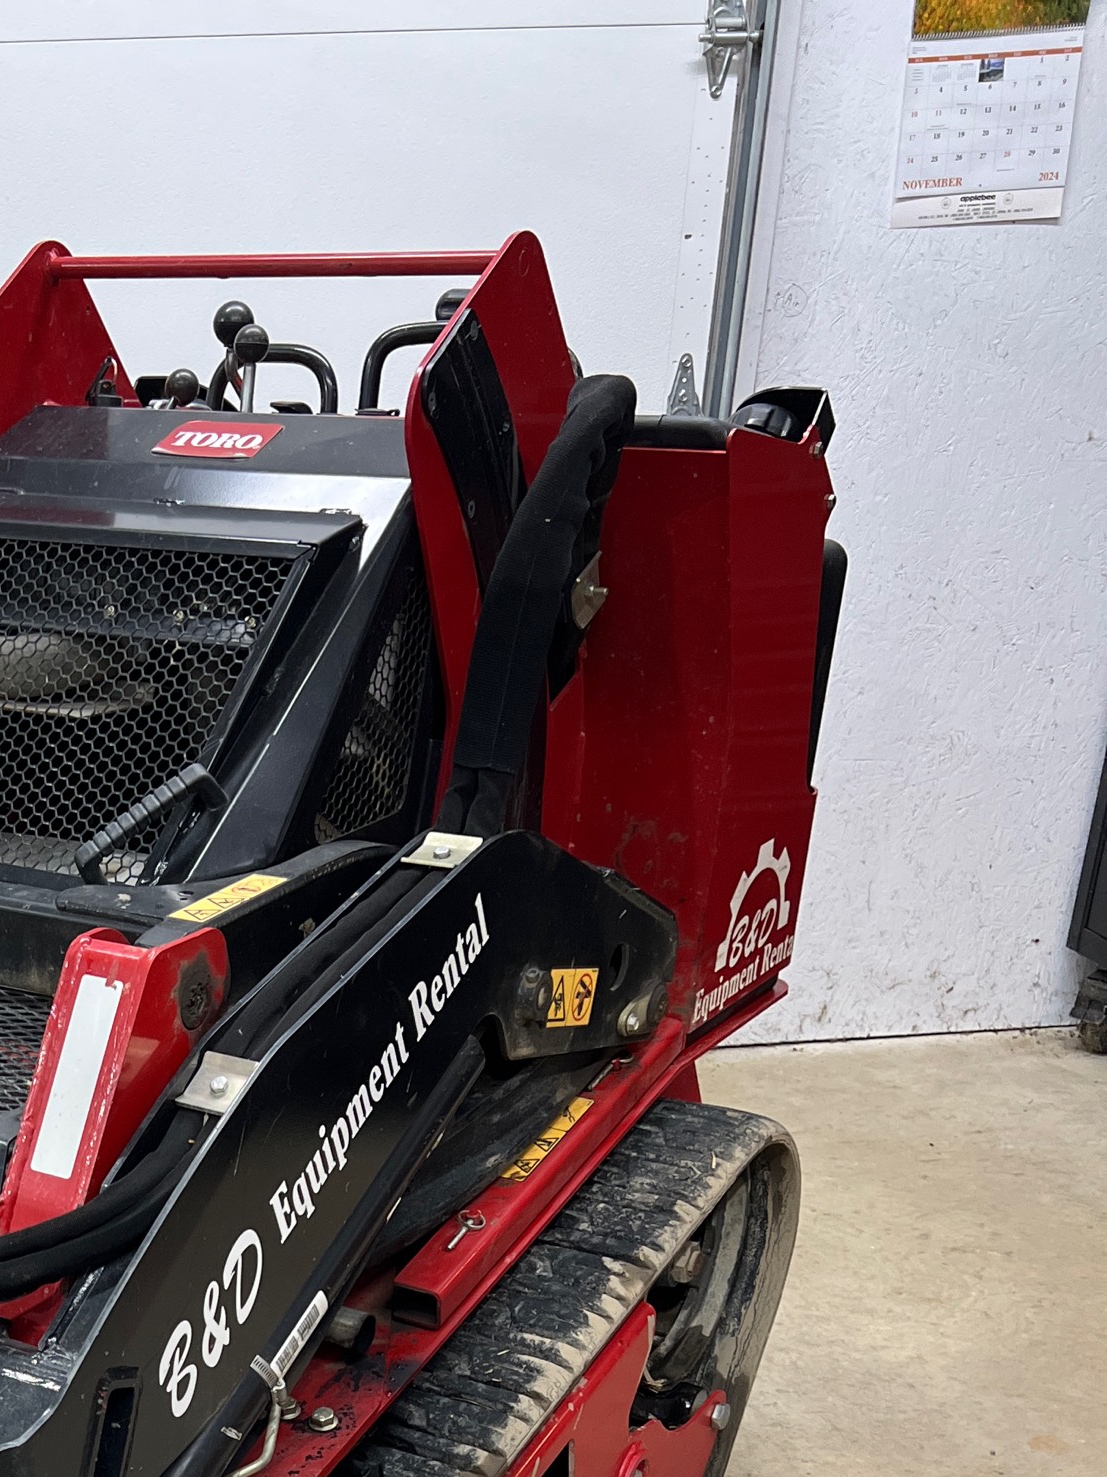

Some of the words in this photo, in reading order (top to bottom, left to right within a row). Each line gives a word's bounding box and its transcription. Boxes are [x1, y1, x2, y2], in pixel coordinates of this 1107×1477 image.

[902, 178, 963, 190] NOVEMBER
[1038, 172, 1059, 181] 2024
[171, 431, 263, 449] TORO
[728, 898, 777, 968] B&D
[692, 955, 760, 1024] Equipment
[760, 935, 794, 975] Renta
[158, 1228, 264, 1417] B&D
[268, 1023, 409, 1244] Equipment
[407, 893, 490, 1042] Rental
